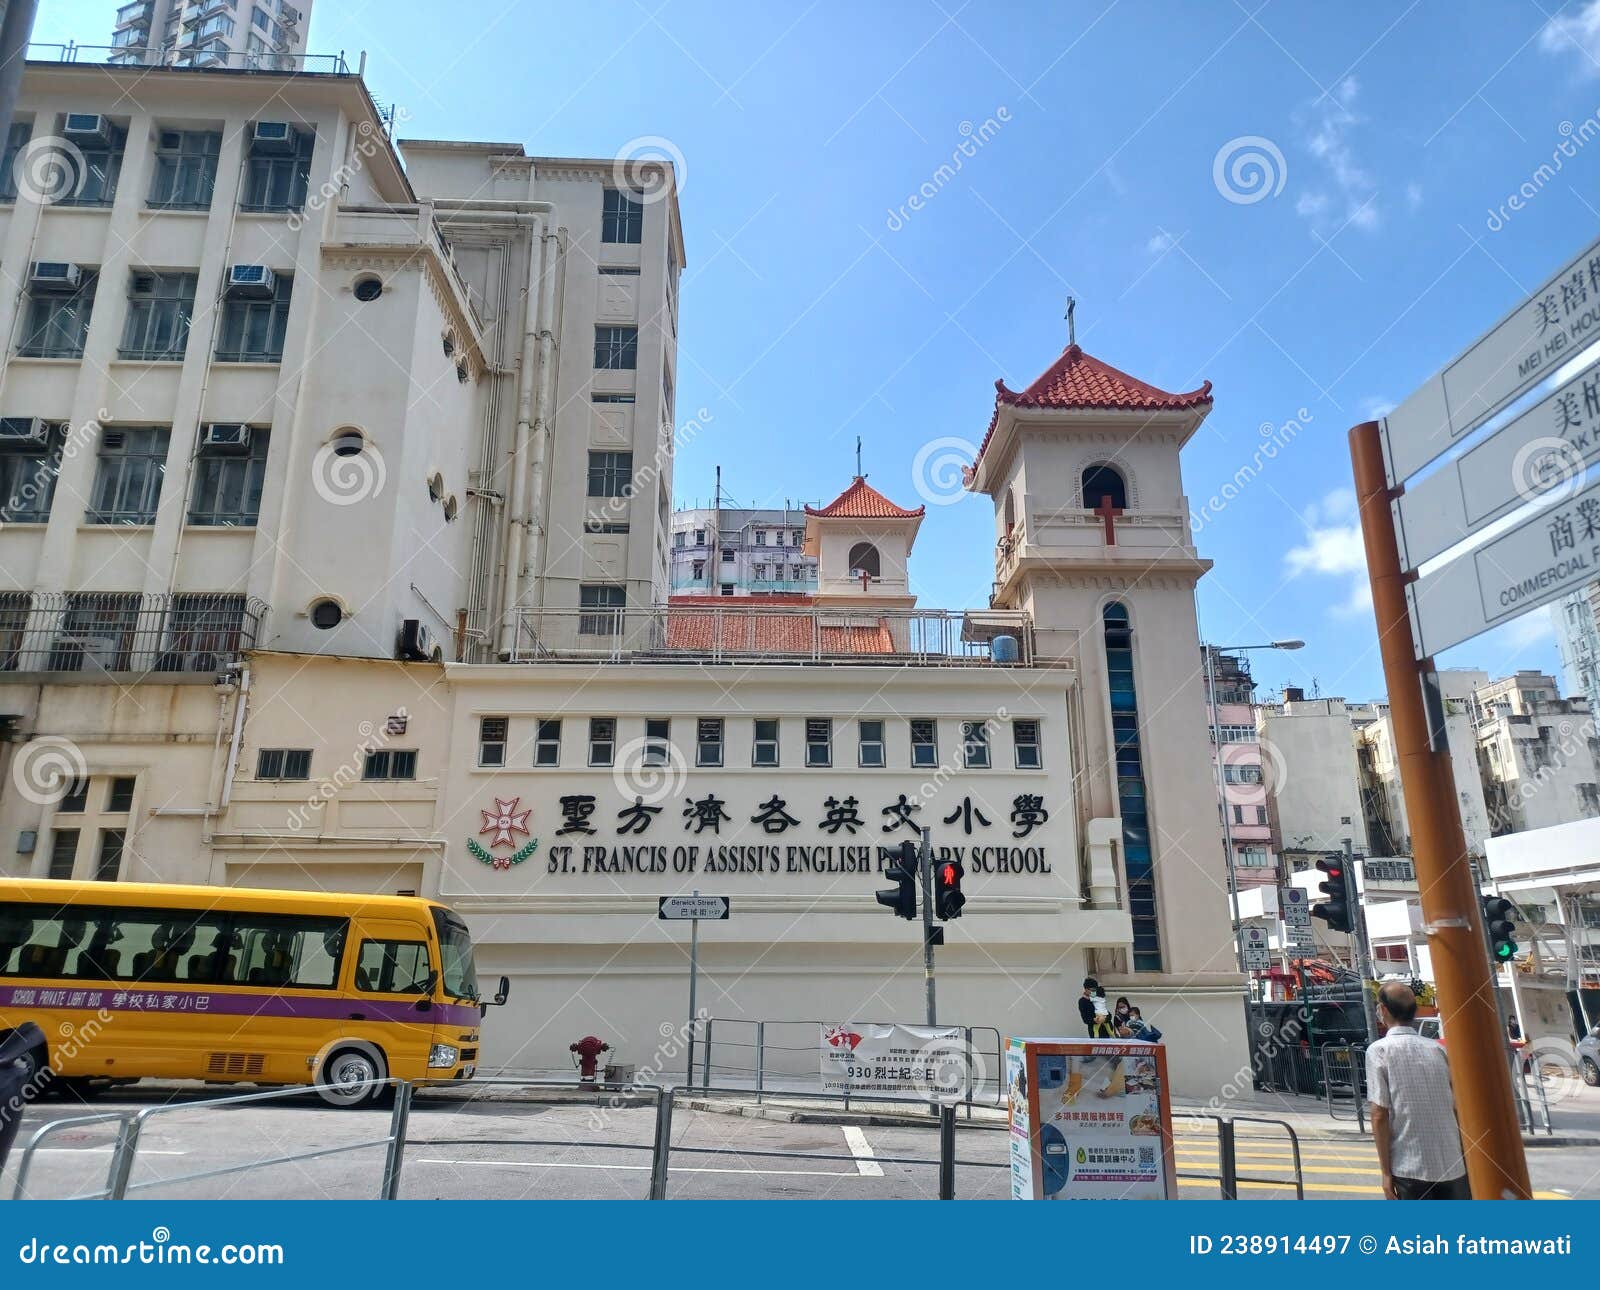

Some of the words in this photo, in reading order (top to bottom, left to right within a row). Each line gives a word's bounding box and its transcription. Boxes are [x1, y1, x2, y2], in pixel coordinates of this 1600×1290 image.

[1518, 350, 1542, 378] MEI
[1544, 331, 1568, 359] HEI
[1547, 498, 1600, 558] 商業
[1500, 554, 1590, 607] COMMERCIAL
[555, 793, 1049, 838] 聖方濟各英文小學
[548, 846, 577, 874] ST.
[582, 846, 668, 874] FRANCIS
[673, 846, 699, 873] OF
[704, 846, 781, 873] ASSISI'S
[786, 846, 871, 874] ENGLISH
[971, 846, 1052, 874] SCHOOL
[12, 990, 36, 1005] SCHOOL
[38, 990, 66, 1006] PRIVATE
[67, 992, 87, 1006] LIGHT
[88, 992, 103, 1007] BUS
[111, 992, 210, 1010] 學校私家小巴
[847, 1067, 872, 1079] 930
[874, 1067, 936, 1081] 烈士紀念日
